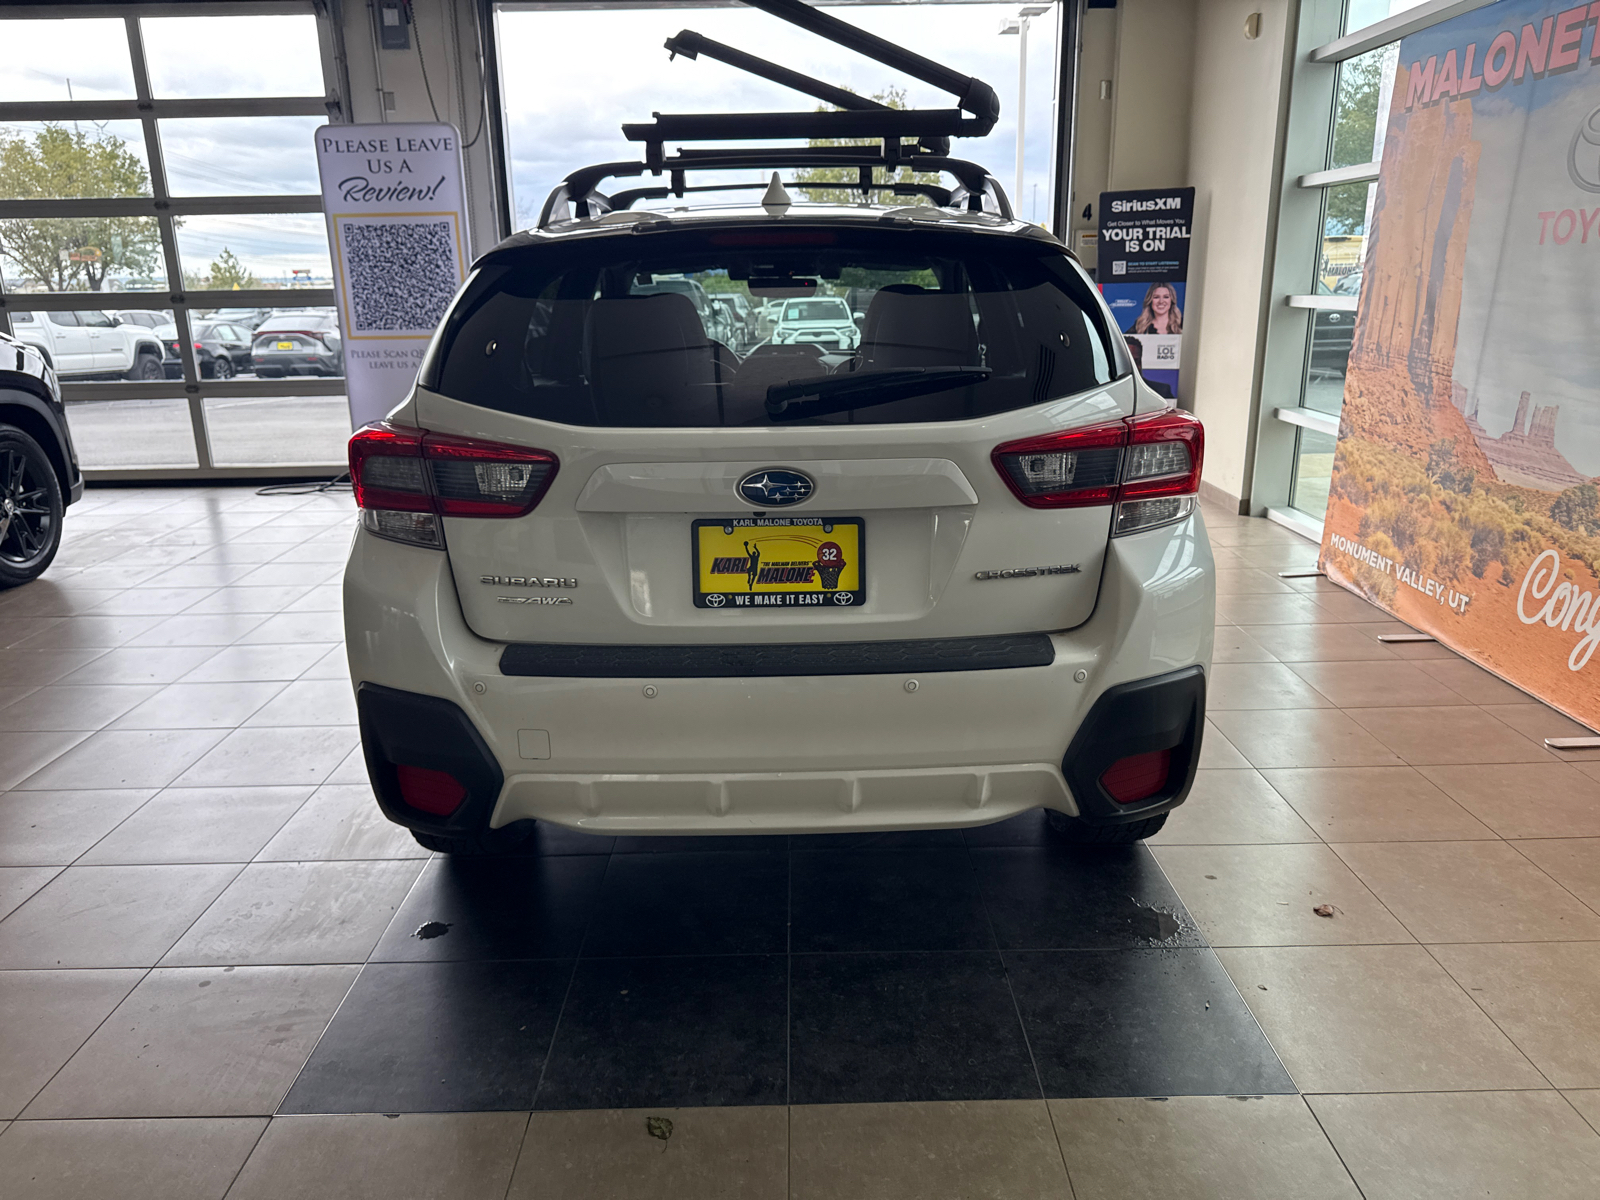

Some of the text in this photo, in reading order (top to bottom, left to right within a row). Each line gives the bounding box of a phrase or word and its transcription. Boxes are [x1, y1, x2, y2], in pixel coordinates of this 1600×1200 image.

[322, 137, 453, 153] PLEASE LEAVE
[367, 159, 413, 174] US A
[338, 175, 446, 203] Review!
[1082, 203, 1092, 221] 4
[1111, 197, 1181, 213] SiriusXM
[1102, 227, 1143, 241] YOUR
[1146, 226, 1190, 239] TRIAL
[1538, 207, 1600, 245] TOY
[1125, 239, 1166, 253] IS ON
[350, 350, 380, 359] PLEASE
[384, 349, 408, 358] SCAN
[1157, 347, 1175, 355] LOL
[369, 361, 417, 369] LEAVE US A
[733, 518, 823, 527] KARL MALONE TOYOTA
[822, 548, 837, 561] 32
[710, 557, 750, 574] KARL
[975, 563, 1082, 580] CROSSTREK
[1331, 532, 1470, 613] MONUMENT VALLEY, UT
[479, 575, 578, 588] SUBARU
[756, 567, 816, 584] MALONE
[735, 594, 824, 605] WE MAKE IT EASY
